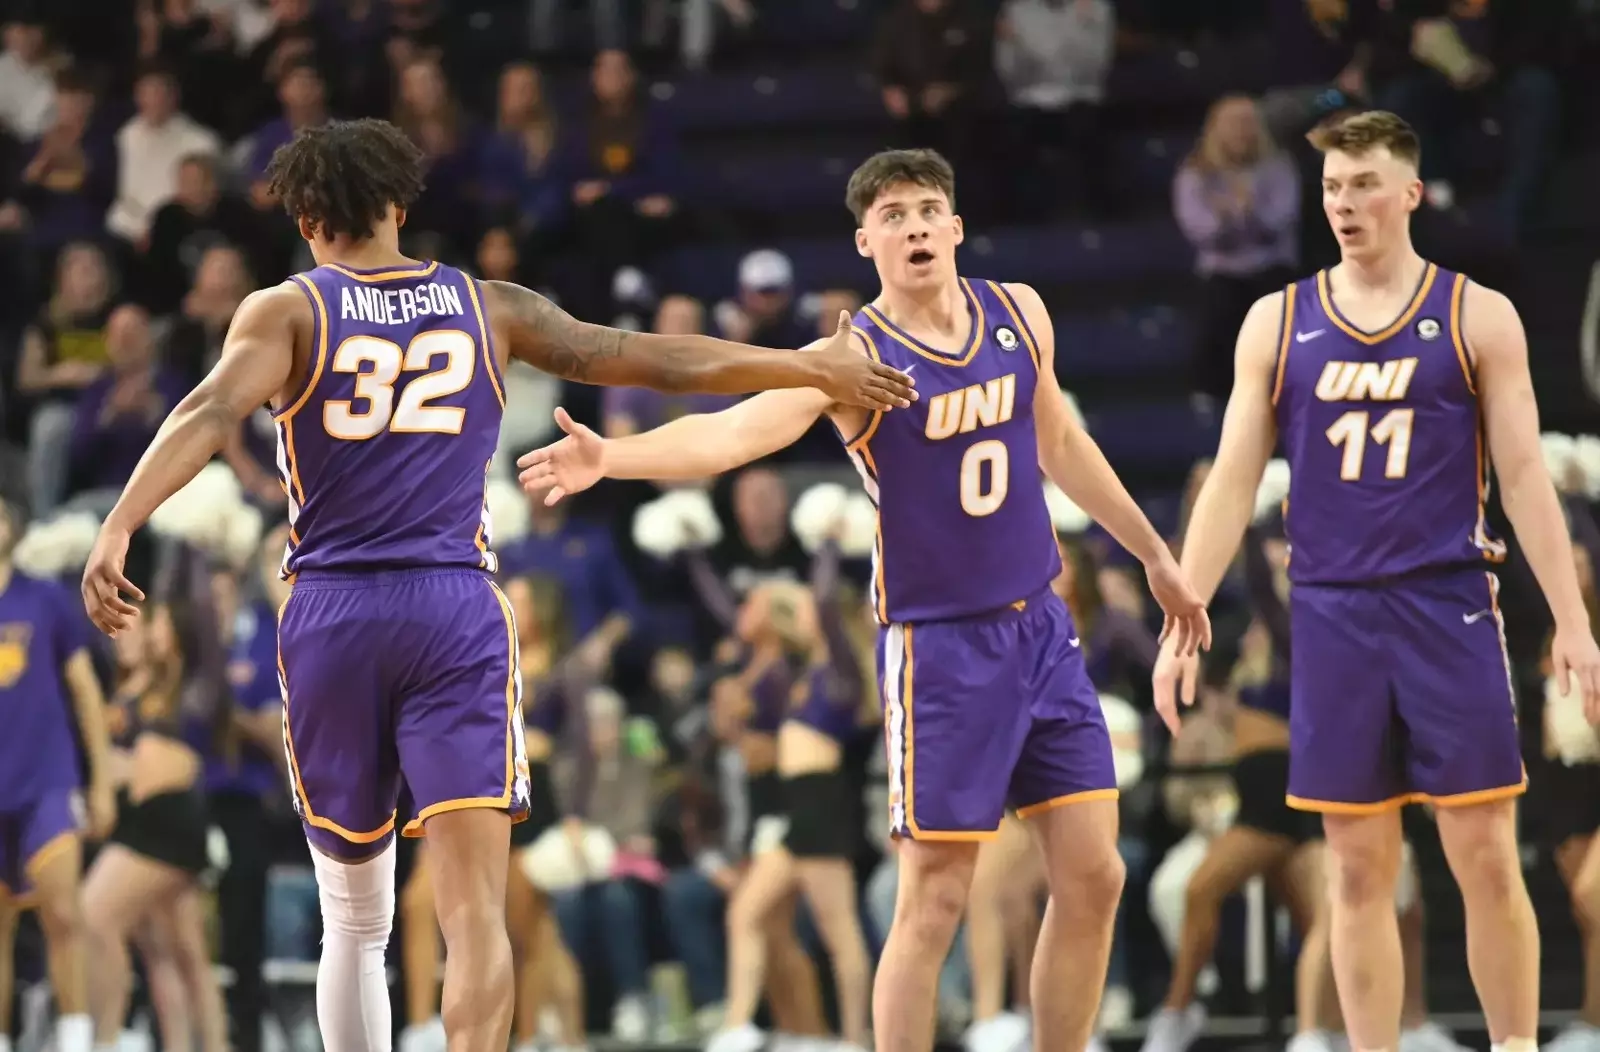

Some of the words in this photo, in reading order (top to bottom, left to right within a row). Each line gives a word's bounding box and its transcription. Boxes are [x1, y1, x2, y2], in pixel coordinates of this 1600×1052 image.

[341, 283, 464, 325] ANDERSON
[323, 329, 476, 440] 32
[924, 373, 1016, 440] UNI
[1315, 357, 1419, 401] UNI
[960, 439, 1009, 517] 0
[1325, 408, 1414, 480] 11
